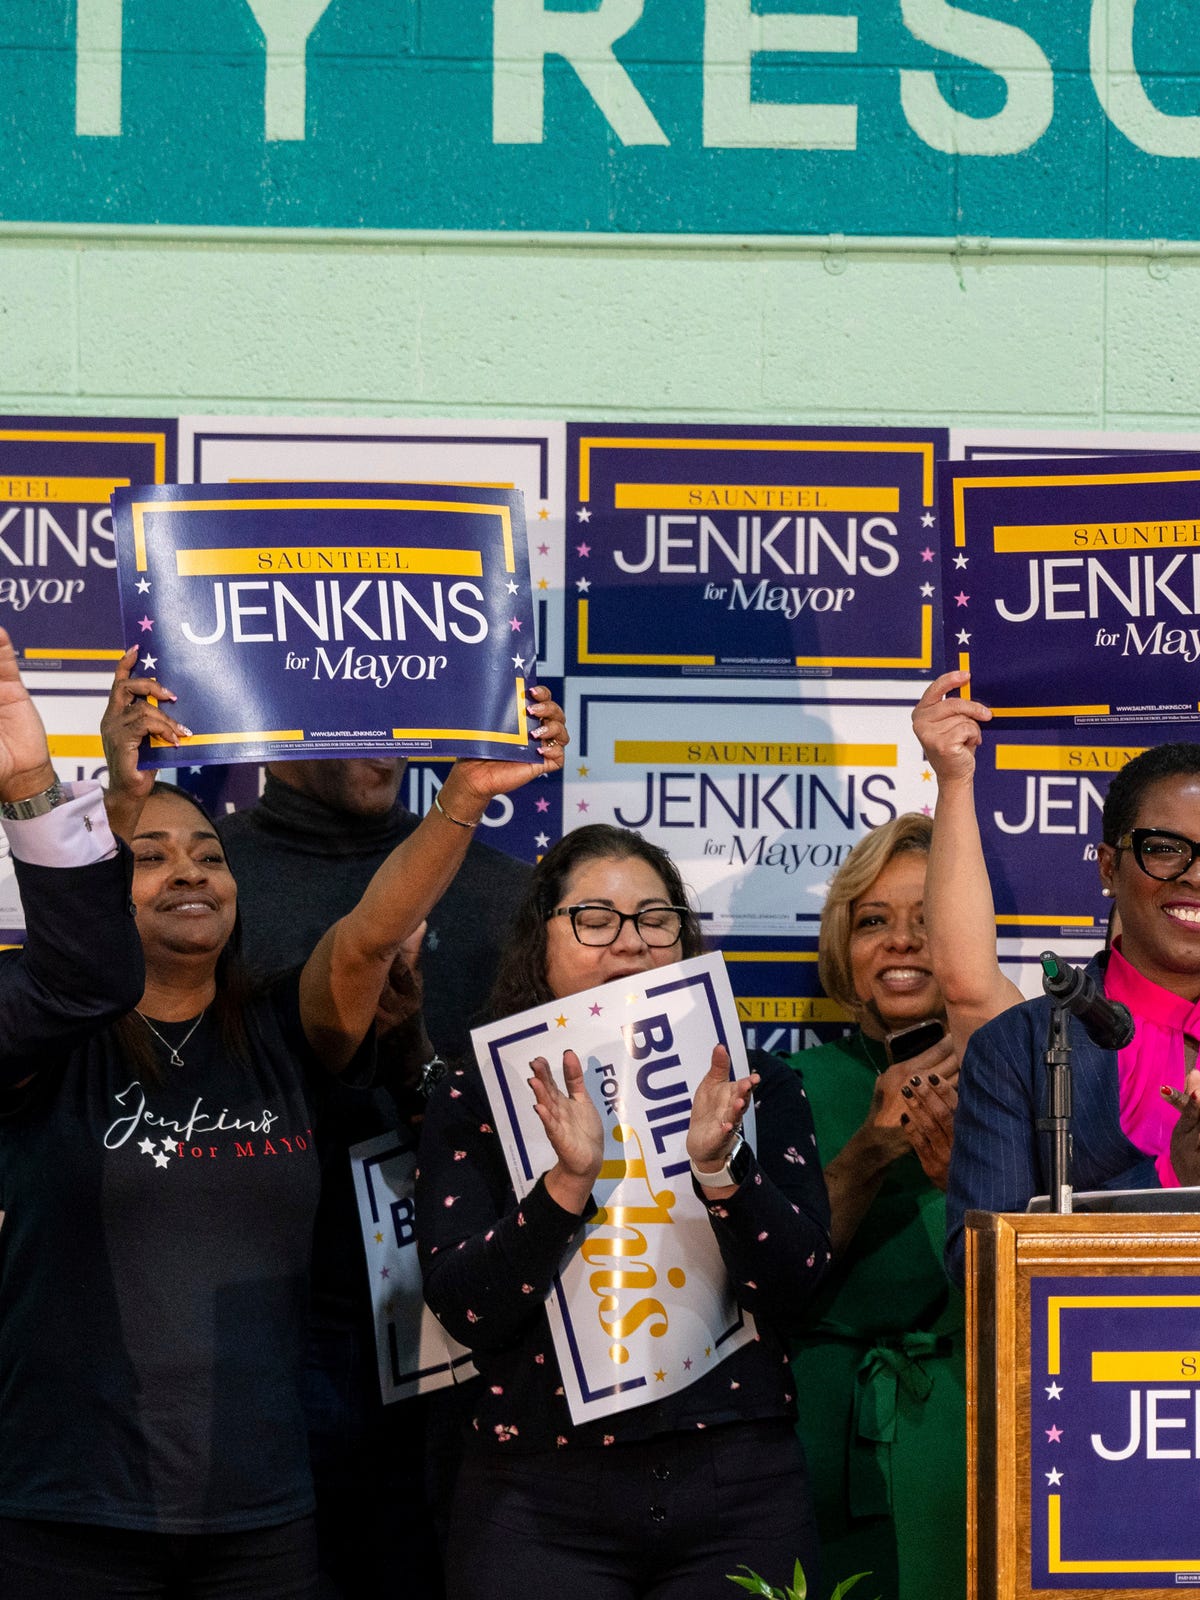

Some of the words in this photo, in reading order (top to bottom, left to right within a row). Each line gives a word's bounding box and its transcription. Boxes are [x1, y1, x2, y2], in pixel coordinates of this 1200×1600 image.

[688, 489, 828, 508] SAUNTEEL
[258, 551, 410, 570] SAUNTEEL
[613, 515, 900, 577] JENKINS
[181, 580, 489, 645] JENKINS
[703, 582, 728, 601] for
[728, 579, 856, 619] Mayor
[1094, 628, 1120, 648] for
[285, 651, 310, 671] for
[313, 647, 447, 689] Mayor
[688, 744, 827, 763] SAUNTEEL
[613, 771, 897, 830] JENKINS
[703, 838, 727, 856] for
[103, 1081, 279, 1150] Jenkins
[176, 1141, 217, 1158] for
[580, 1123, 687, 1365] This.
